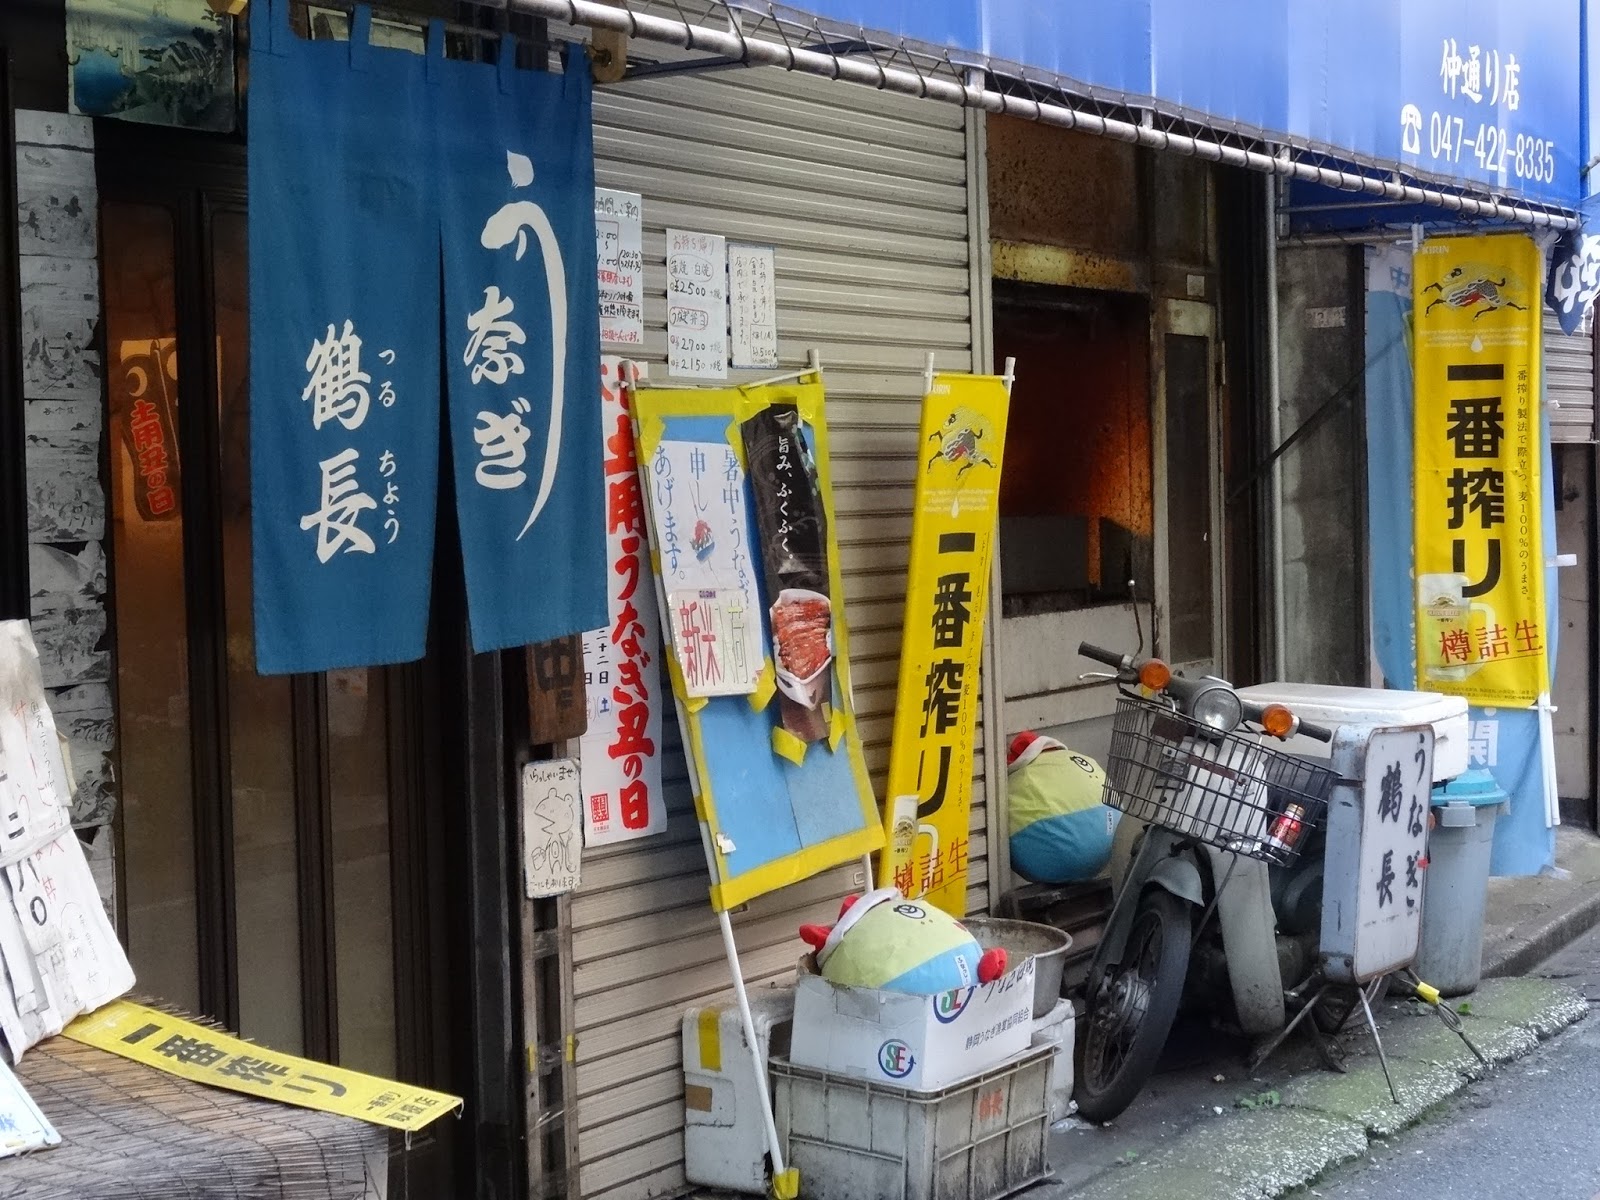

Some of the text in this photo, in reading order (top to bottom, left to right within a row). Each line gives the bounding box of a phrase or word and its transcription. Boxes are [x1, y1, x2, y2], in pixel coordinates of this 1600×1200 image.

[1440, 38, 1521, 111] 仲通り店
[1430, 111, 1555, 184] 047-422-8335
[1422, 246, 1450, 255] KIRIN
[378, 349, 396, 408] つる
[463, 149, 568, 542] う奈ぎ
[131, 400, 175, 515] 土用丑の日
[300, 318, 378, 564] 鶴長
[776, 435, 794, 559] 旨み、ふくふく。
[1446, 363, 1505, 599] 一番搾り
[654, 445, 686, 580] あげます。
[917, 532, 976, 819] 一番搾り
[1439, 619, 1543, 664] 樽詰生
[893, 837, 968, 899] 樽詰生
[1376, 760, 1404, 910] 鶴長
[1406, 733, 1426, 916] うなぎ
[121, 1022, 348, 1098] 一番搾り
[885, 1043, 907, 1073] SE
